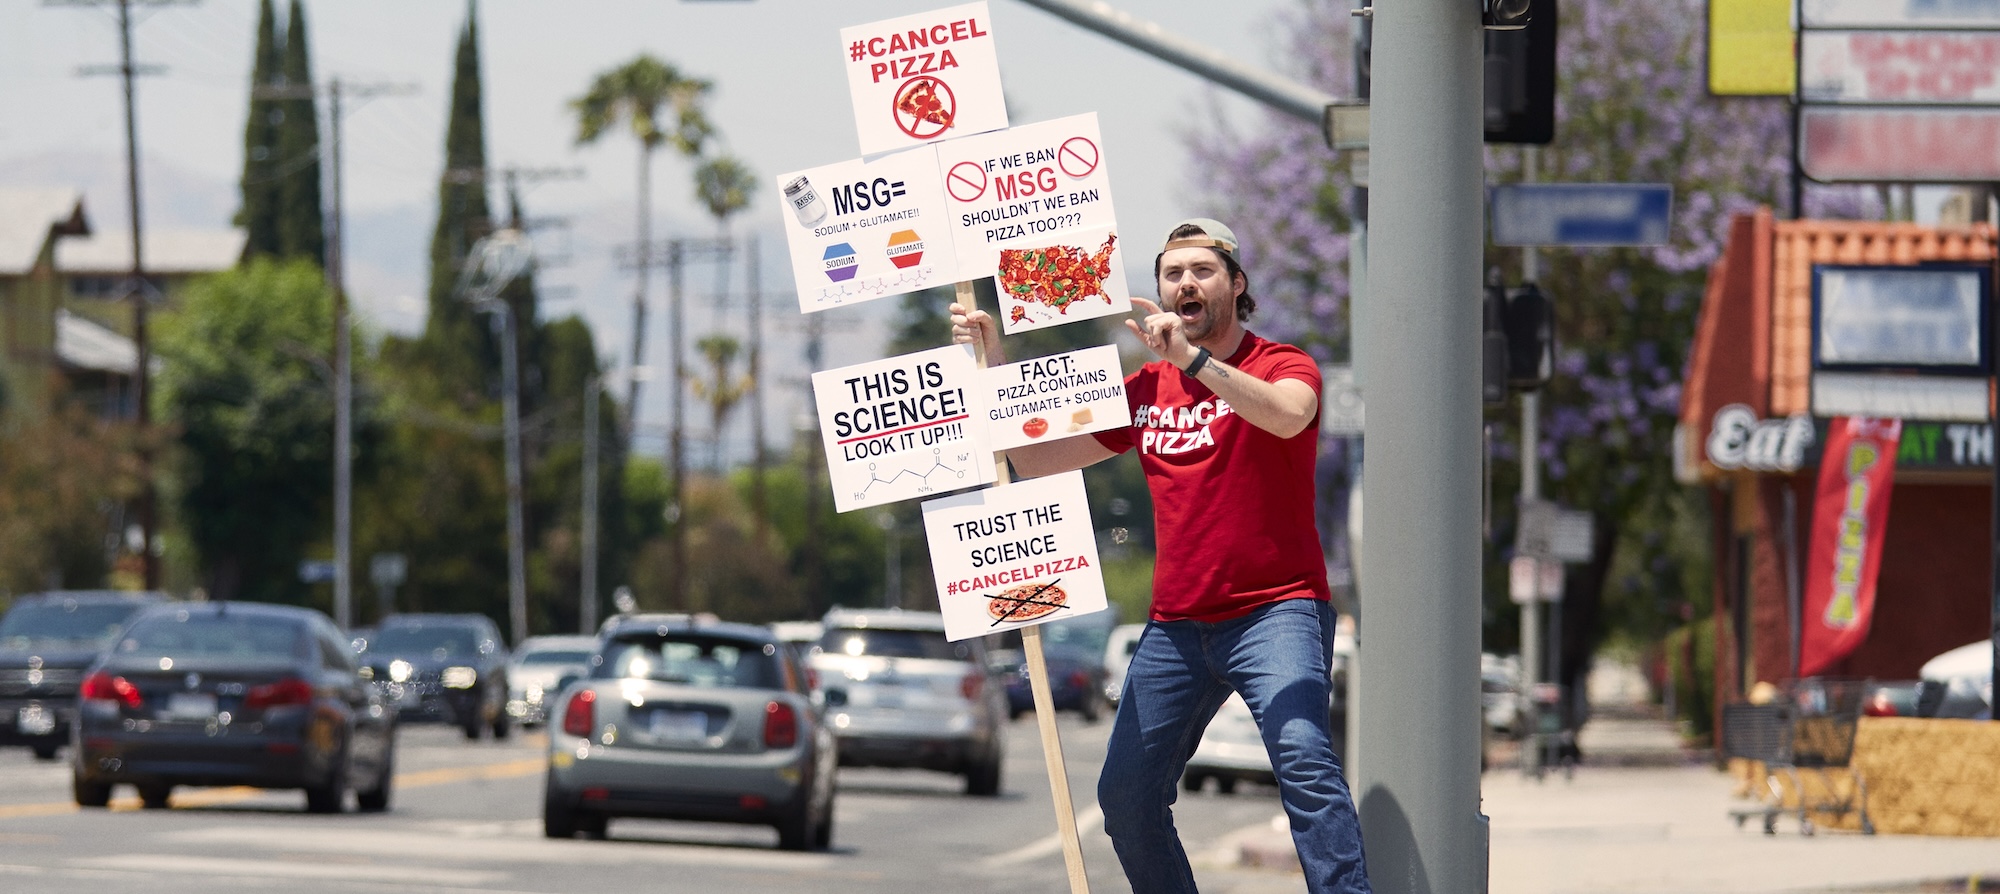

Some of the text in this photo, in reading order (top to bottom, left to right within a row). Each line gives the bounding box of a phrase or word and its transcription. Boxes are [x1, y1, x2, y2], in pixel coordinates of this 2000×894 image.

[849, 18, 987, 62] #CANCEL
[870, 49, 959, 83] PIZZA
[984, 147, 1055, 173] IF WE BAN
[796, 193, 814, 207] MSG
[832, 177, 906, 216] MSG=
[995, 167, 1058, 202] MSG
[814, 222, 850, 237] SODIUM
[859, 208, 920, 228] GLUTAMATE!!
[962, 188, 1099, 227] SHOULDN'T WE BAN
[986, 212, 1081, 243] PIZZA TOO???
[825, 256, 856, 269] SODIUM
[886, 242, 925, 256] GLUTAMATE
[844, 362, 944, 404] THIS IS
[997, 369, 1107, 401] PIZZA CONTAINS
[1020, 355, 1076, 382] FACT:
[834, 388, 966, 438] SCIENCE!
[989, 397, 1062, 421] GLUTAMATE
[1074, 385, 1122, 404] SODIUM
[1133, 399, 1235, 428] #CANCE
[844, 423, 964, 462] LOOK IT UP!!!
[1141, 424, 1215, 455] PIZZA
[1706, 402, 1814, 472] Eat
[953, 503, 1063, 542] TRUST THE
[1824, 440, 1878, 629] PIZZA
[971, 534, 1057, 568] SCIENCE
[947, 555, 1090, 596] #CANCELPIZZA
